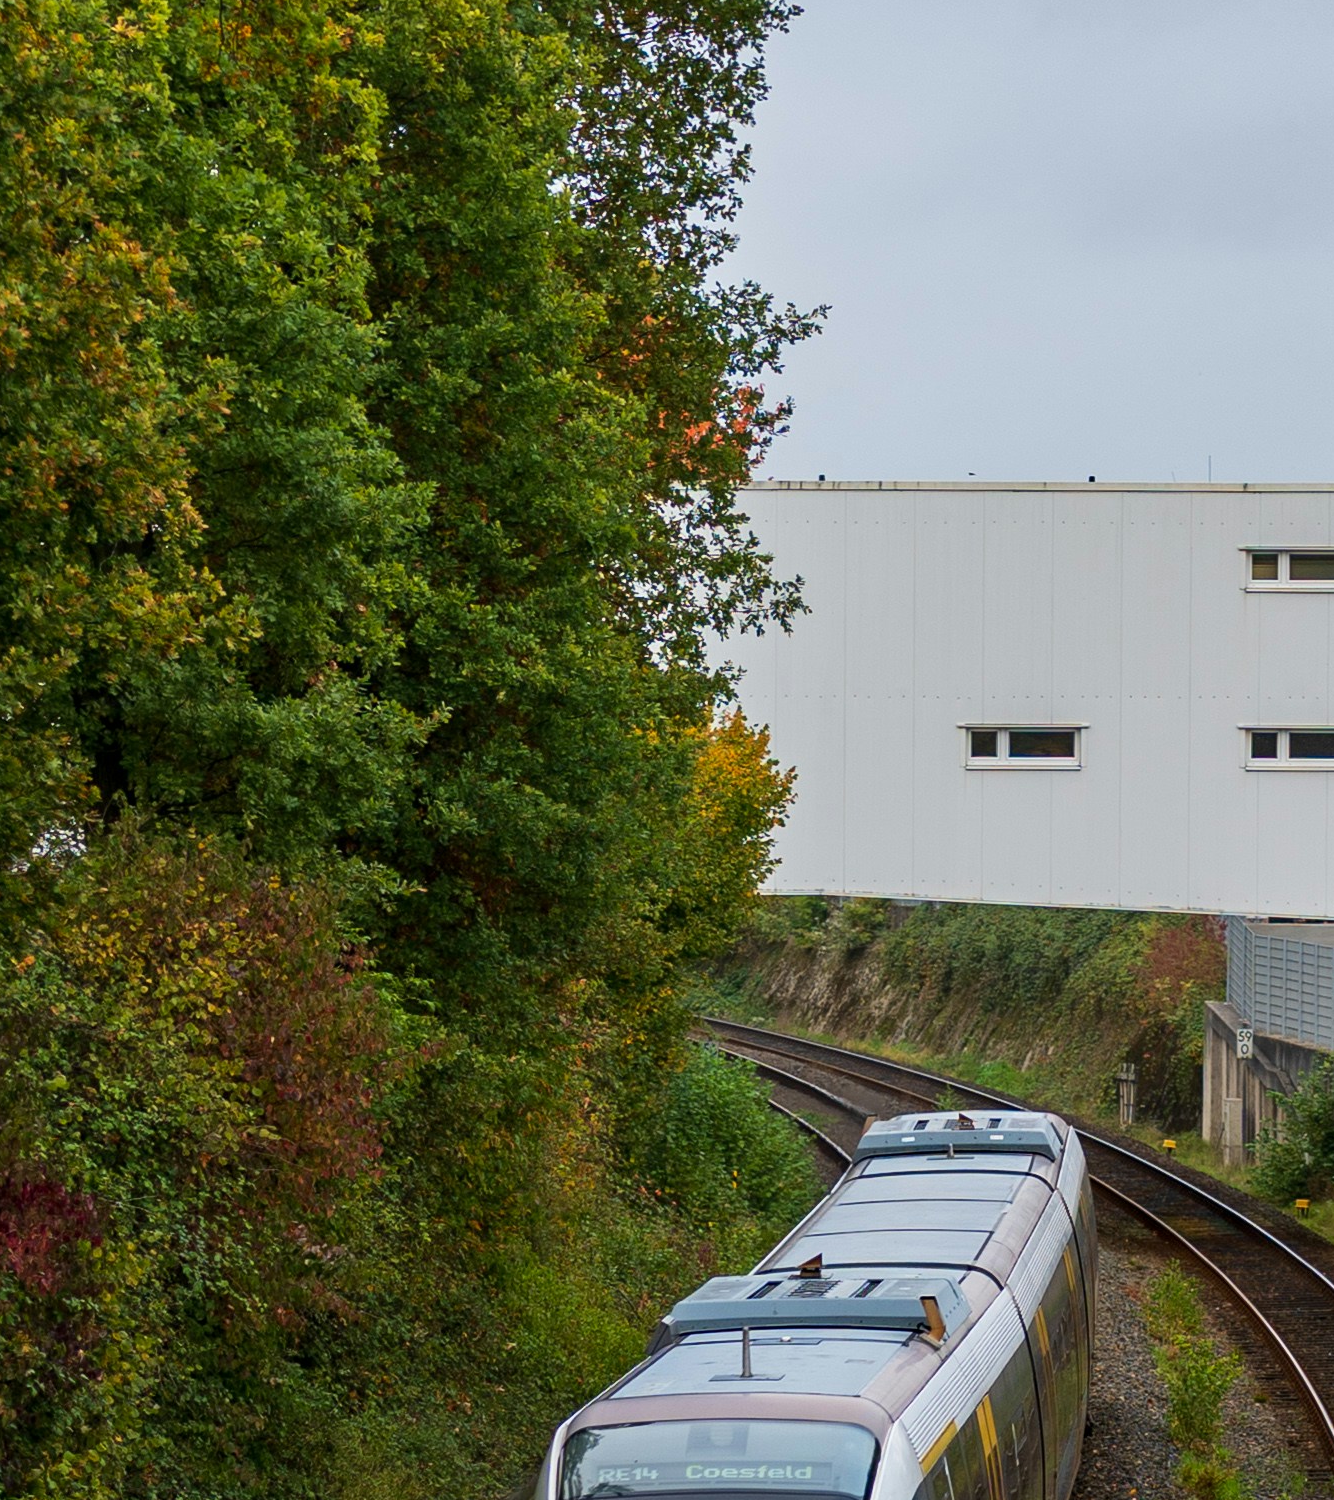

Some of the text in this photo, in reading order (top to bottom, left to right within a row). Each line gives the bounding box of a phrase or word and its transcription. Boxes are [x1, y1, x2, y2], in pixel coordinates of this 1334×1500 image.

[1238, 1031, 1252, 1042] 59
[1241, 1044, 1249, 1055] 0
[598, 1464, 813, 1483] RE14 Coesfeld
